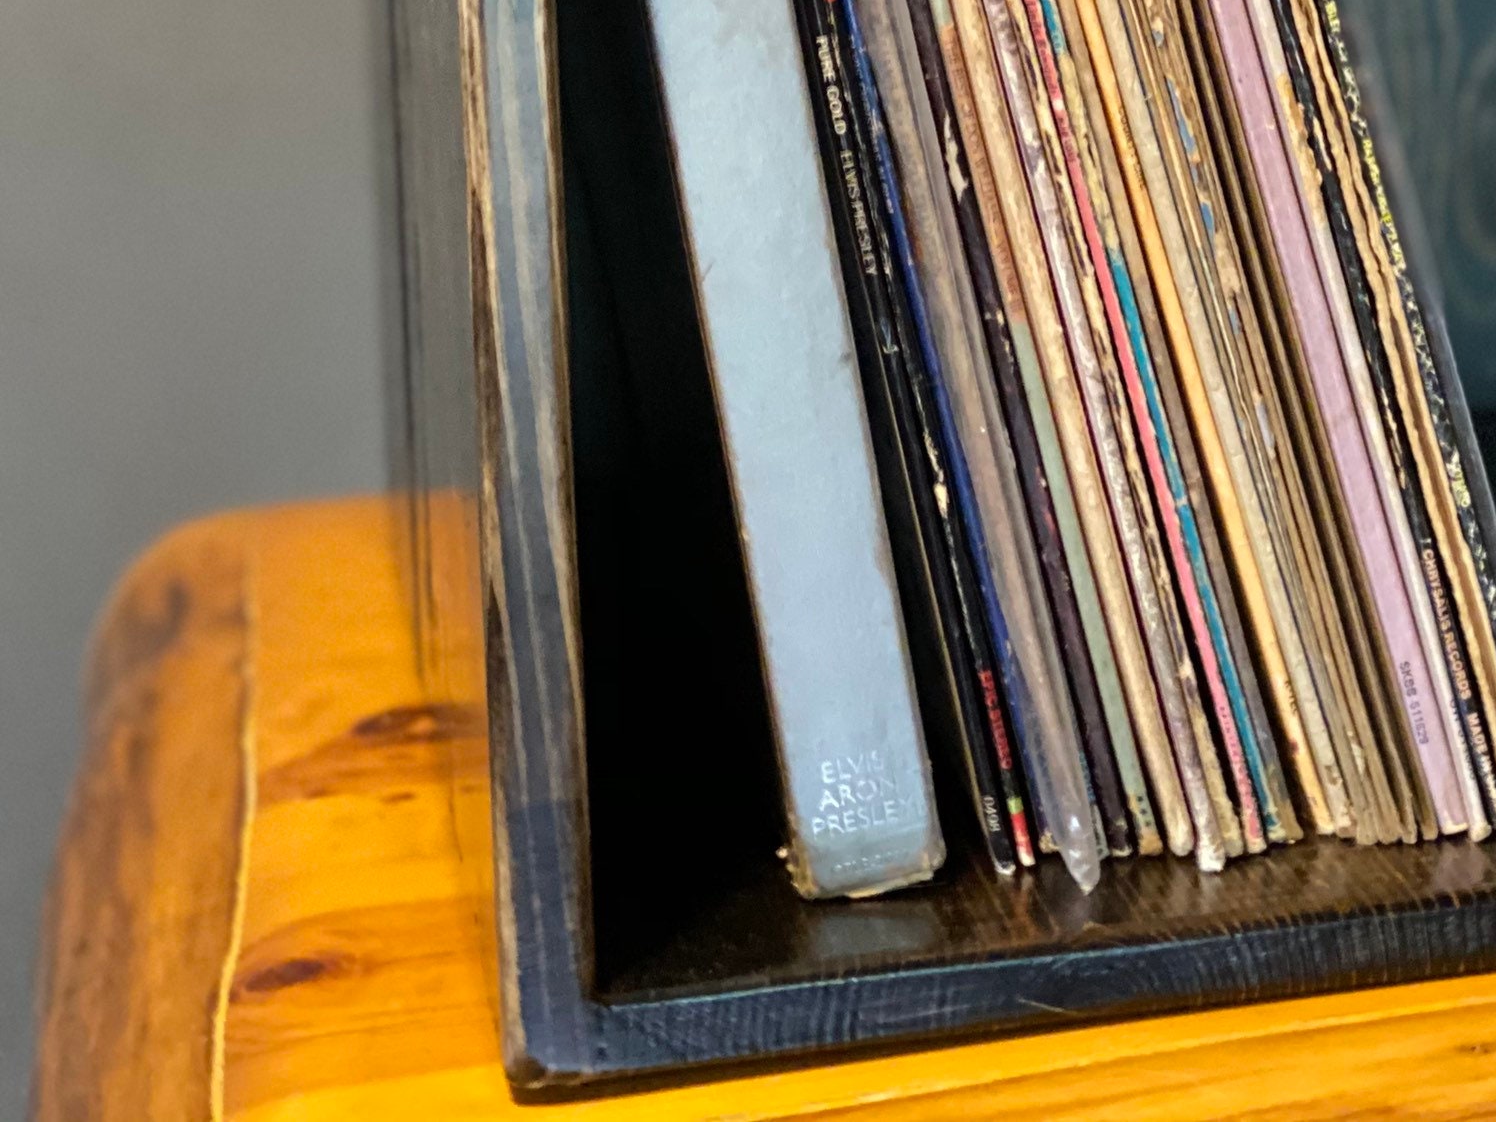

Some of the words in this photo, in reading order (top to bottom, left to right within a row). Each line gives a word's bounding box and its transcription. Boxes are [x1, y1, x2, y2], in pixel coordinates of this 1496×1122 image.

[812, 33, 837, 84] PURE
[824, 82, 849, 136] GOLD
[837, 146, 862, 200] ELVIS
[848, 198, 879, 279] PRESLEY
[1420, 546, 1455, 632] CHRYSALIS
[1442, 630, 1474, 702] RECORDS
[1464, 710, 1489, 754] MADE
[977, 668, 1000, 708] EPIC
[986, 705, 1014, 772] STEREO
[820, 750, 885, 784] ELVIS
[812, 794, 915, 840] PRESLEY
[819, 777, 896, 812] ARON
